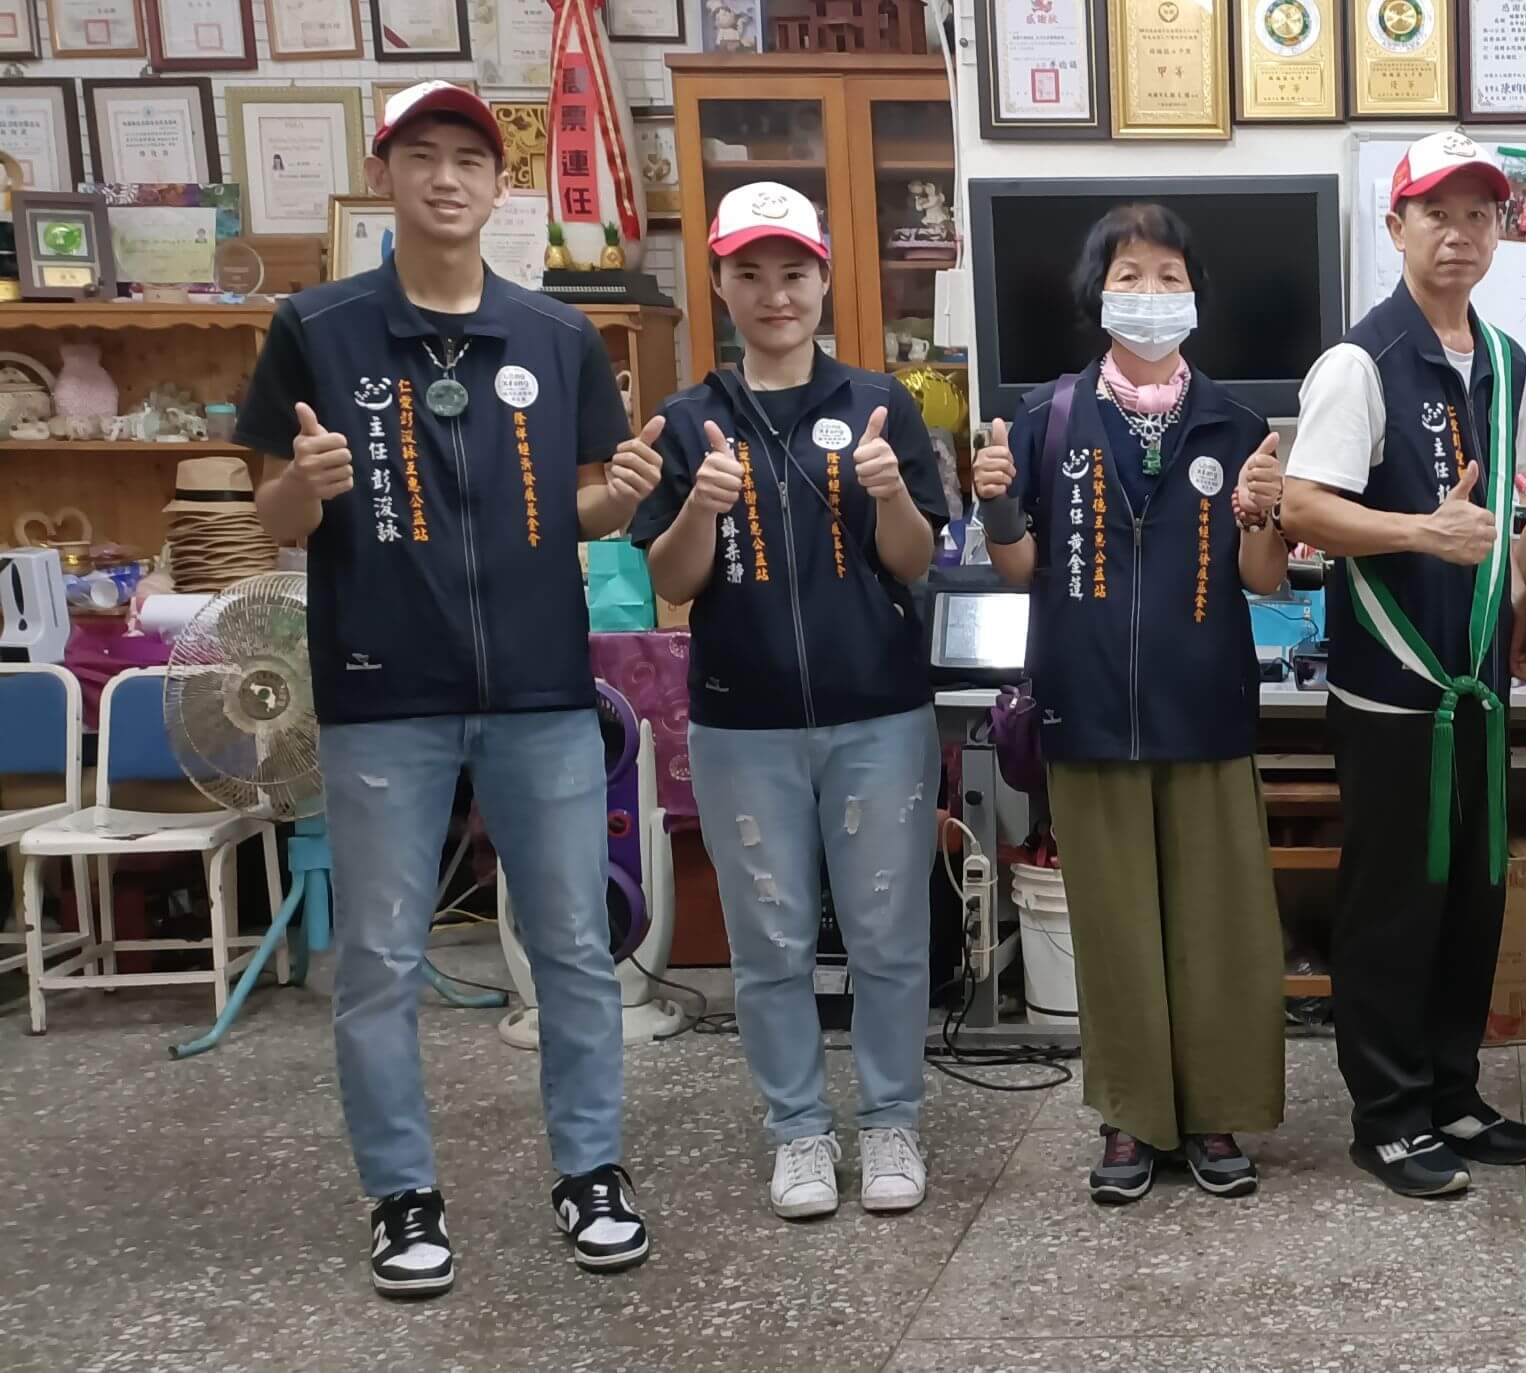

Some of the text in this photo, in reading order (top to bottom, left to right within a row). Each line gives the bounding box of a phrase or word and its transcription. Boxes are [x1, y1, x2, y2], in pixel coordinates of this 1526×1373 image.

[368, 416, 388, 461] 主任
[1434, 437, 1449, 478] 主任
[1070, 485, 1084, 525] 主任
